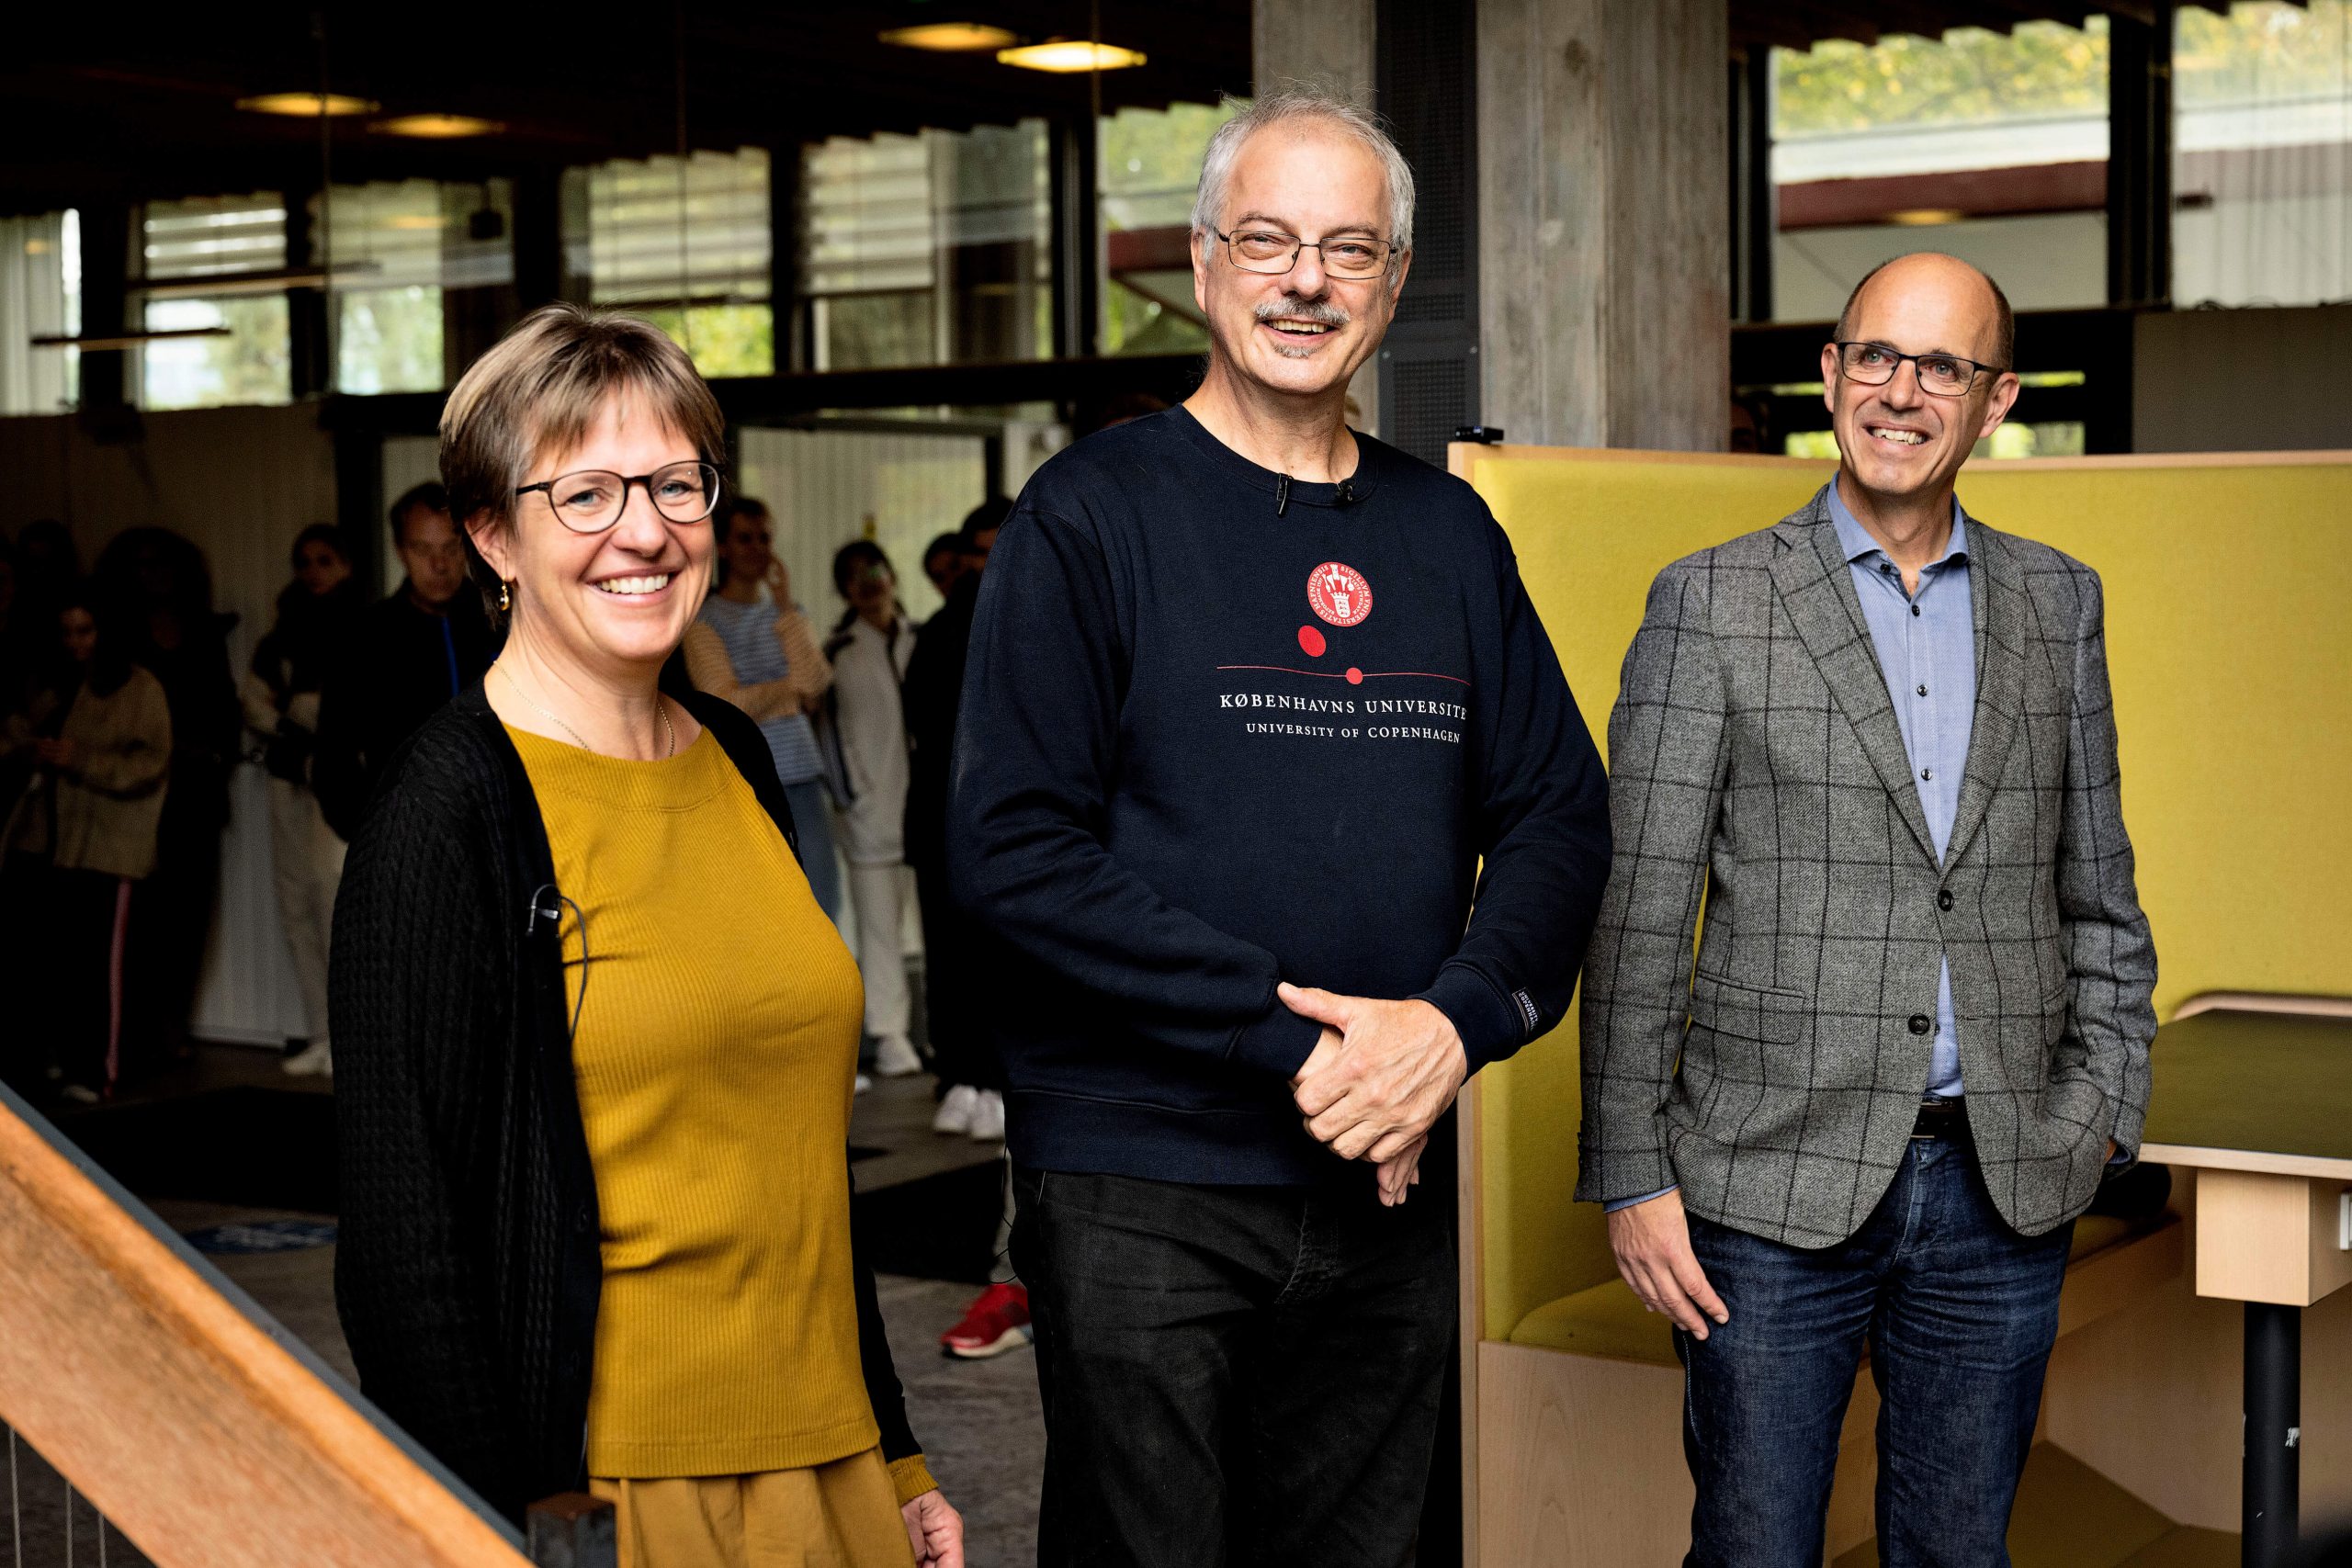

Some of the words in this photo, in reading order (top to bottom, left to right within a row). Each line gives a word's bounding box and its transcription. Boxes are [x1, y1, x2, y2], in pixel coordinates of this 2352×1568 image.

[1220, 694, 1355, 714] KØBENHAVNS
[1246, 724, 1335, 738] UNIVERSITY
[1341, 728, 1359, 739] OF
[1368, 728, 1461, 744] COPENHAGEN
